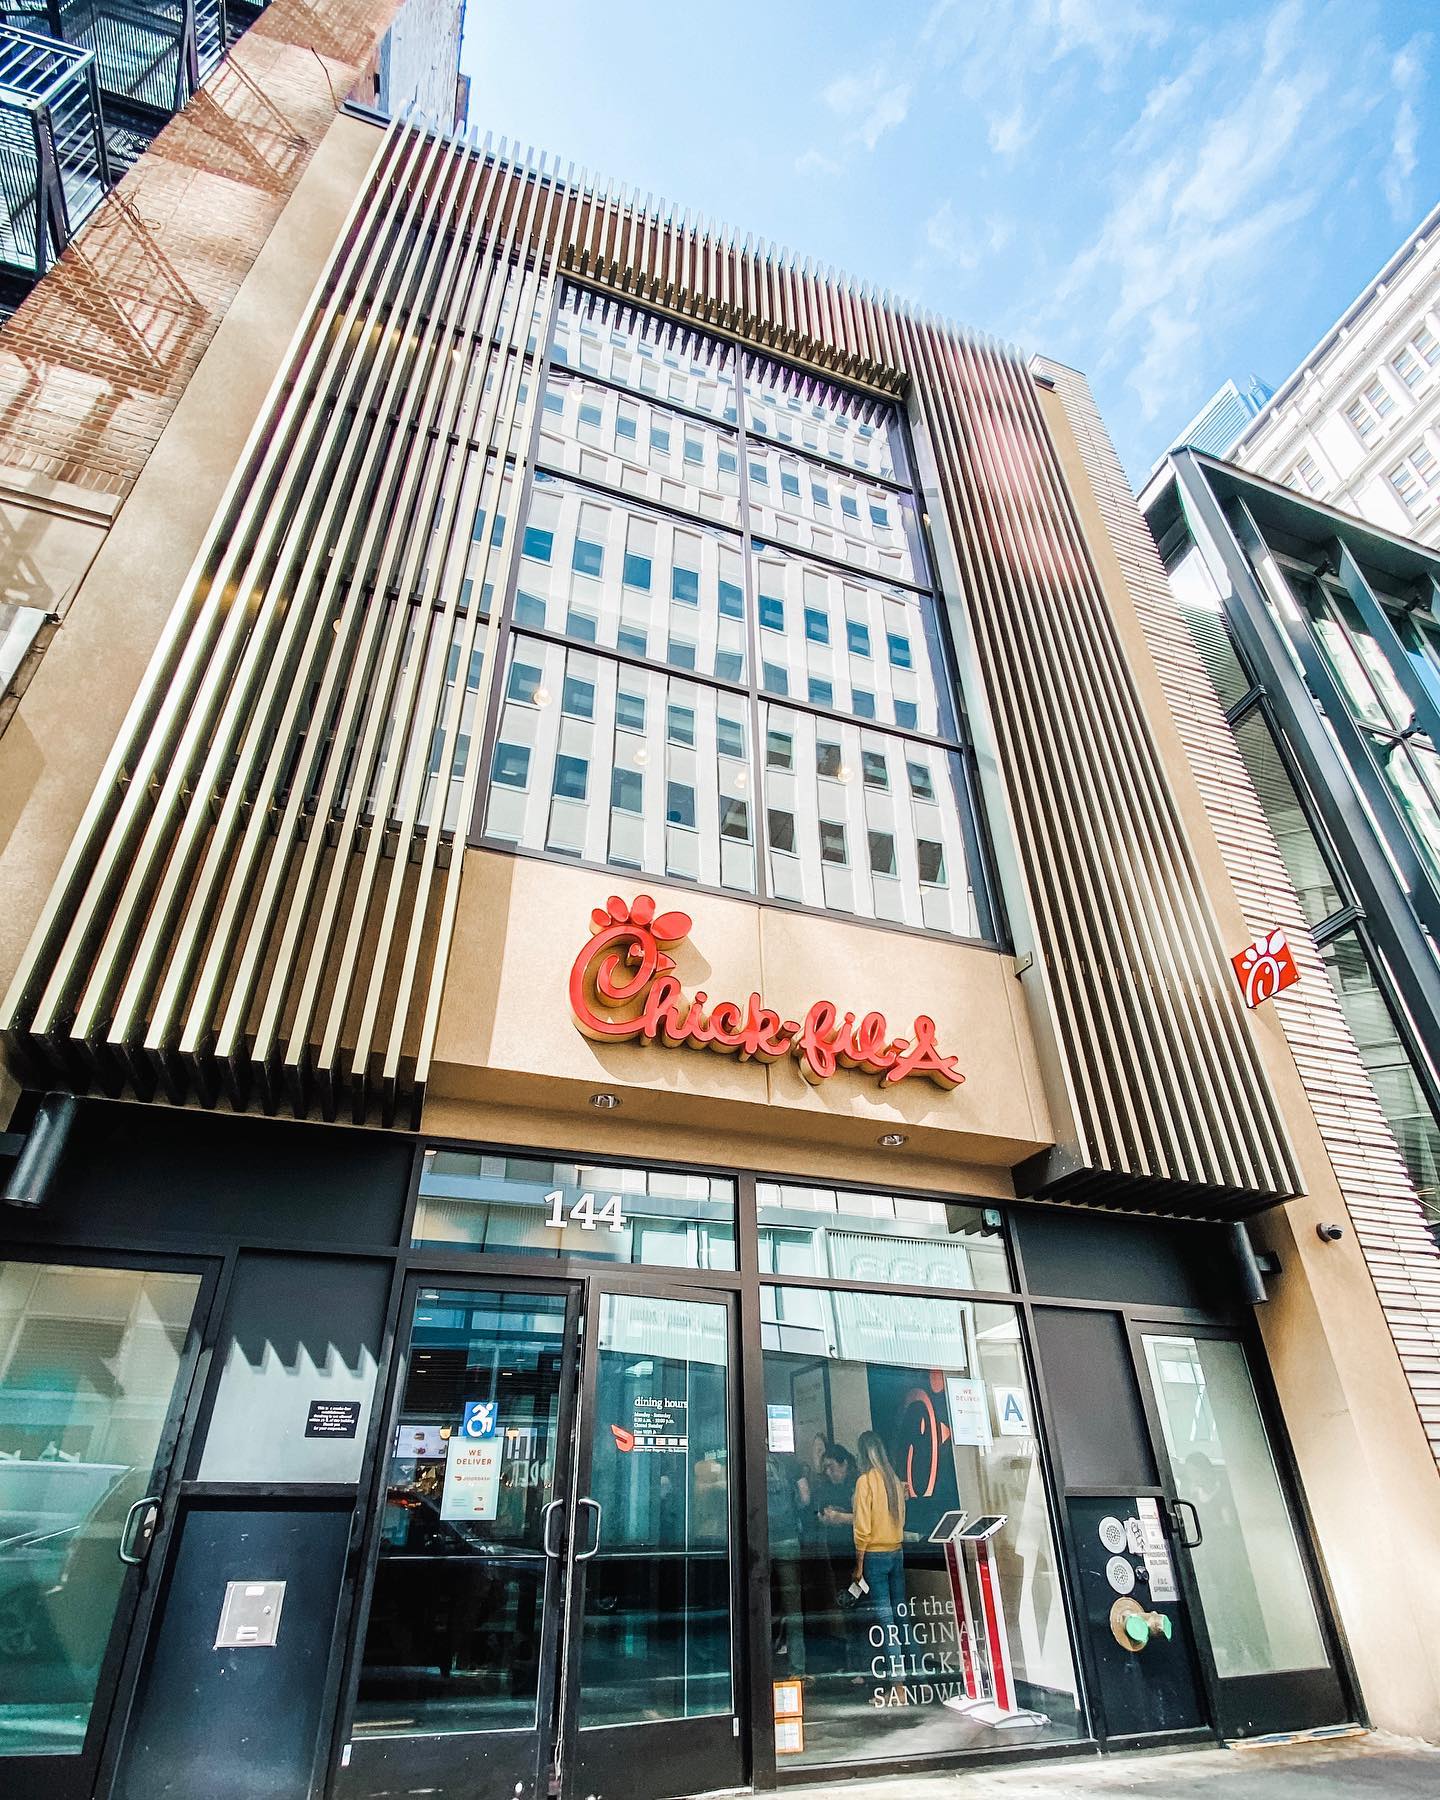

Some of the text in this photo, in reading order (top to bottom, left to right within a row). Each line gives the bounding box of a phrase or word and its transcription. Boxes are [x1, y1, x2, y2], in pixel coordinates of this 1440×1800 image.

[544, 1189, 628, 1233] 144
[634, 1396, 688, 1410] dining hours
[1004, 1393, 1025, 1422] A
[456, 1458, 492, 1466] DELIVER
[469, 1449, 482, 1457] WE
[896, 1595, 954, 1618] of the
[873, 1680, 993, 1709] SANDWIH
